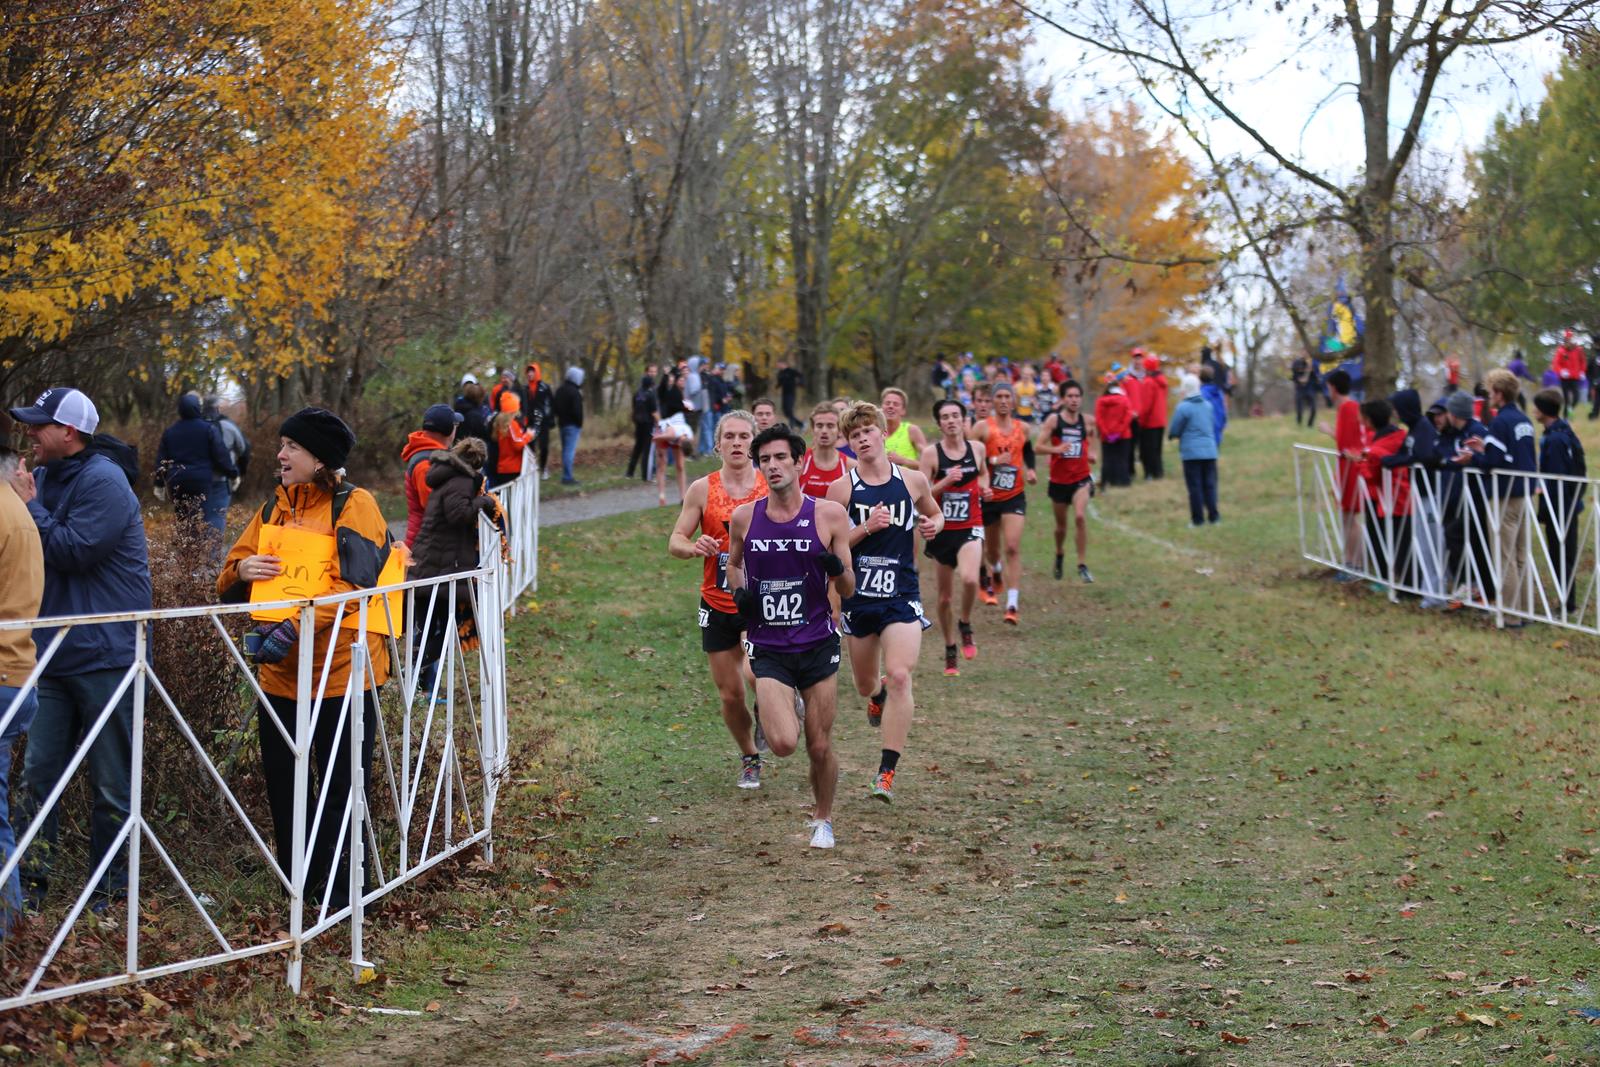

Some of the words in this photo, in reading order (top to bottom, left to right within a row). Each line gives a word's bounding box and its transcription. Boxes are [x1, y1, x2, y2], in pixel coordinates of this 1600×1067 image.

[854, 500, 906, 527] TJ
[943, 501, 969, 518] 672
[750, 539, 812, 552] NYU
[860, 567, 896, 593] 748
[762, 593, 803, 620] 642
